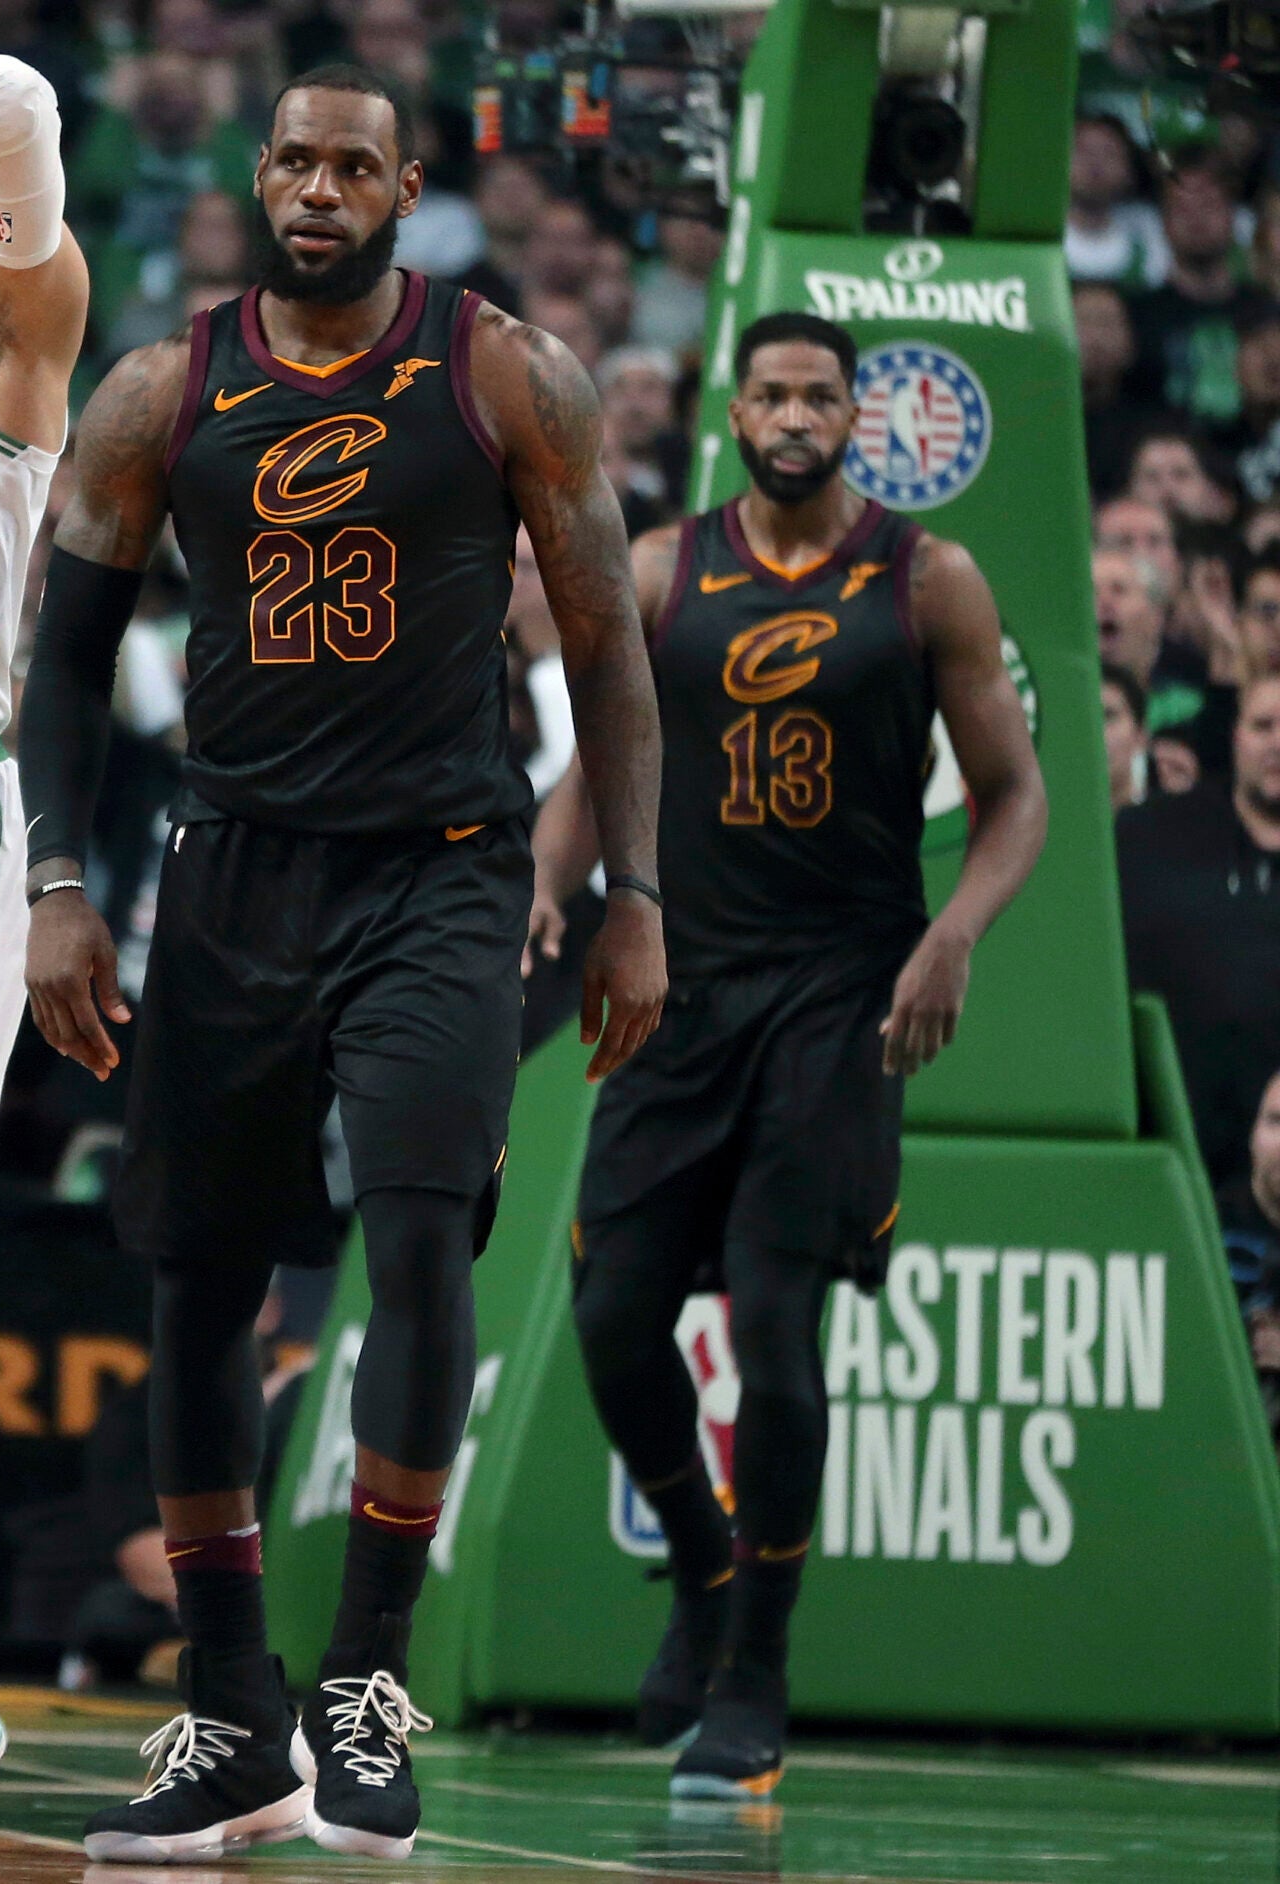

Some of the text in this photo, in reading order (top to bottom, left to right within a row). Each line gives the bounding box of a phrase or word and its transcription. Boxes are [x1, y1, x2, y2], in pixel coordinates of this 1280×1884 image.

[805, 268, 1032, 333] SPALDING
[253, 414, 386, 524] C
[247, 527, 396, 663] 23
[723, 610, 839, 704] C
[720, 709, 833, 828] 13
[823, 1243, 1167, 1410] ASTERN
[821, 1402, 1077, 1567] INALS
